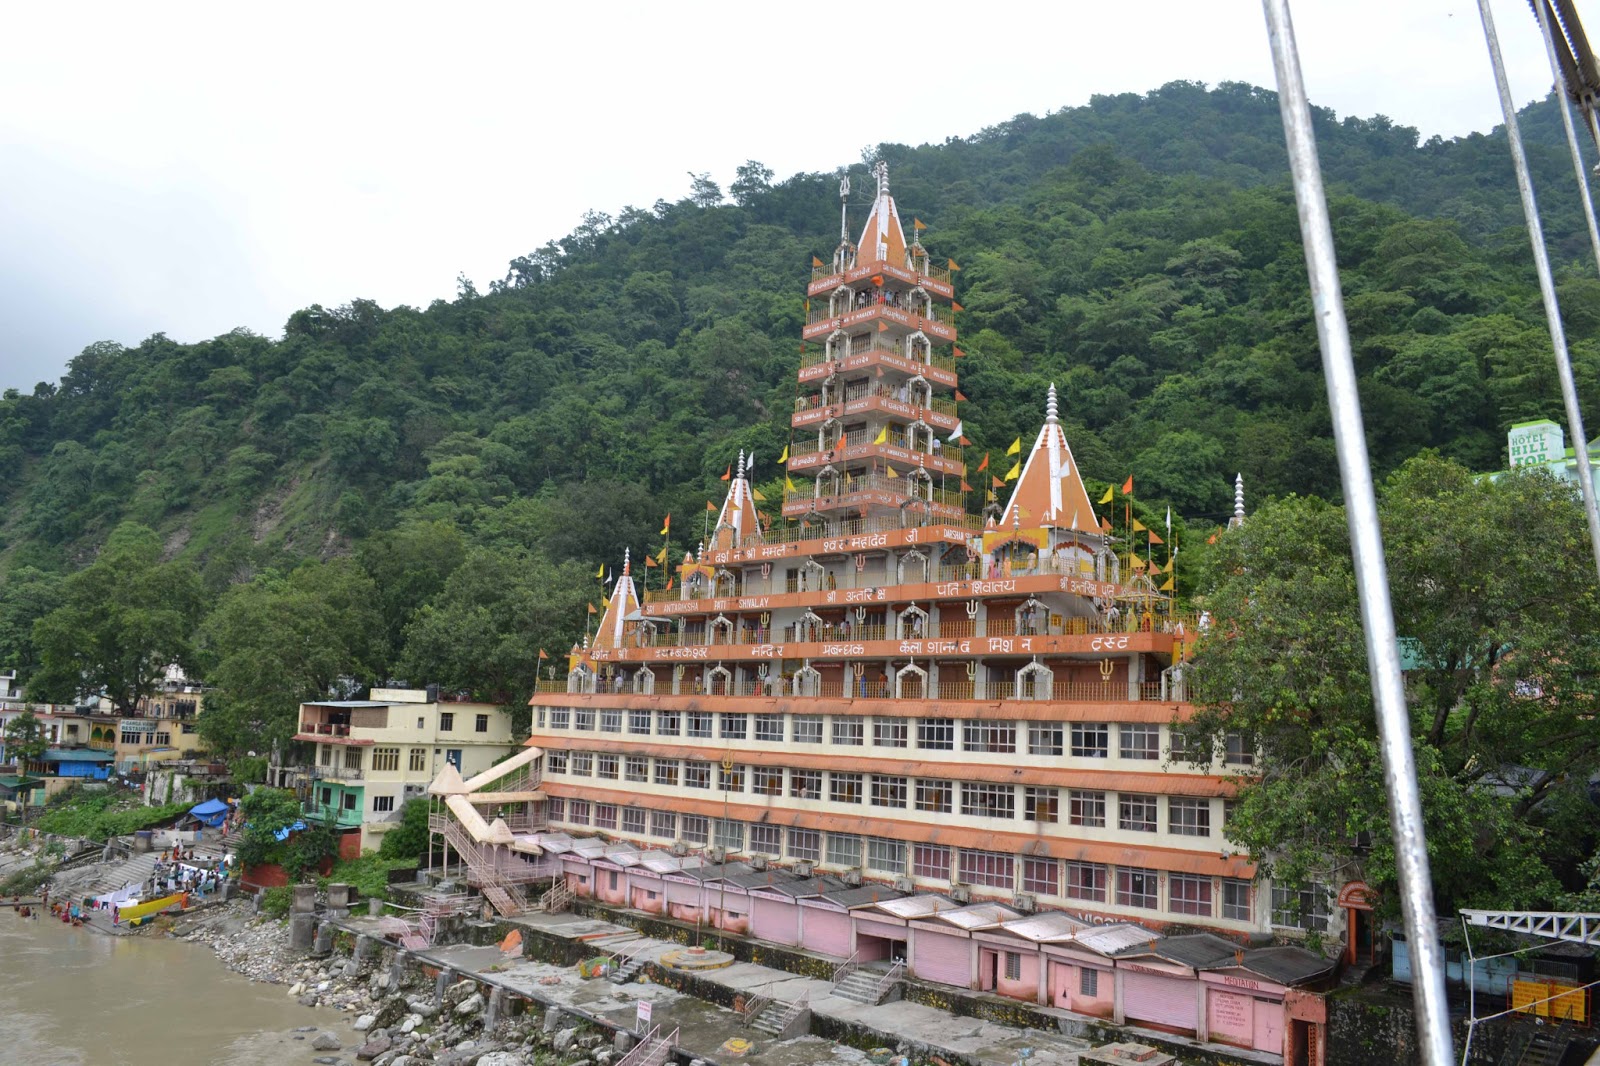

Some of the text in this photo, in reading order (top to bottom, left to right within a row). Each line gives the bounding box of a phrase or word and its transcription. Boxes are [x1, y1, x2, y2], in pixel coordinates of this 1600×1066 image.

[1512, 433, 1546, 446] HOTEL
[1511, 441, 1548, 456] HILL
[851, 533, 888, 548] महादेव
[936, 582, 959, 596] पति
[971, 580, 1016, 594] शिवालय
[646, 605, 655, 614] SRI
